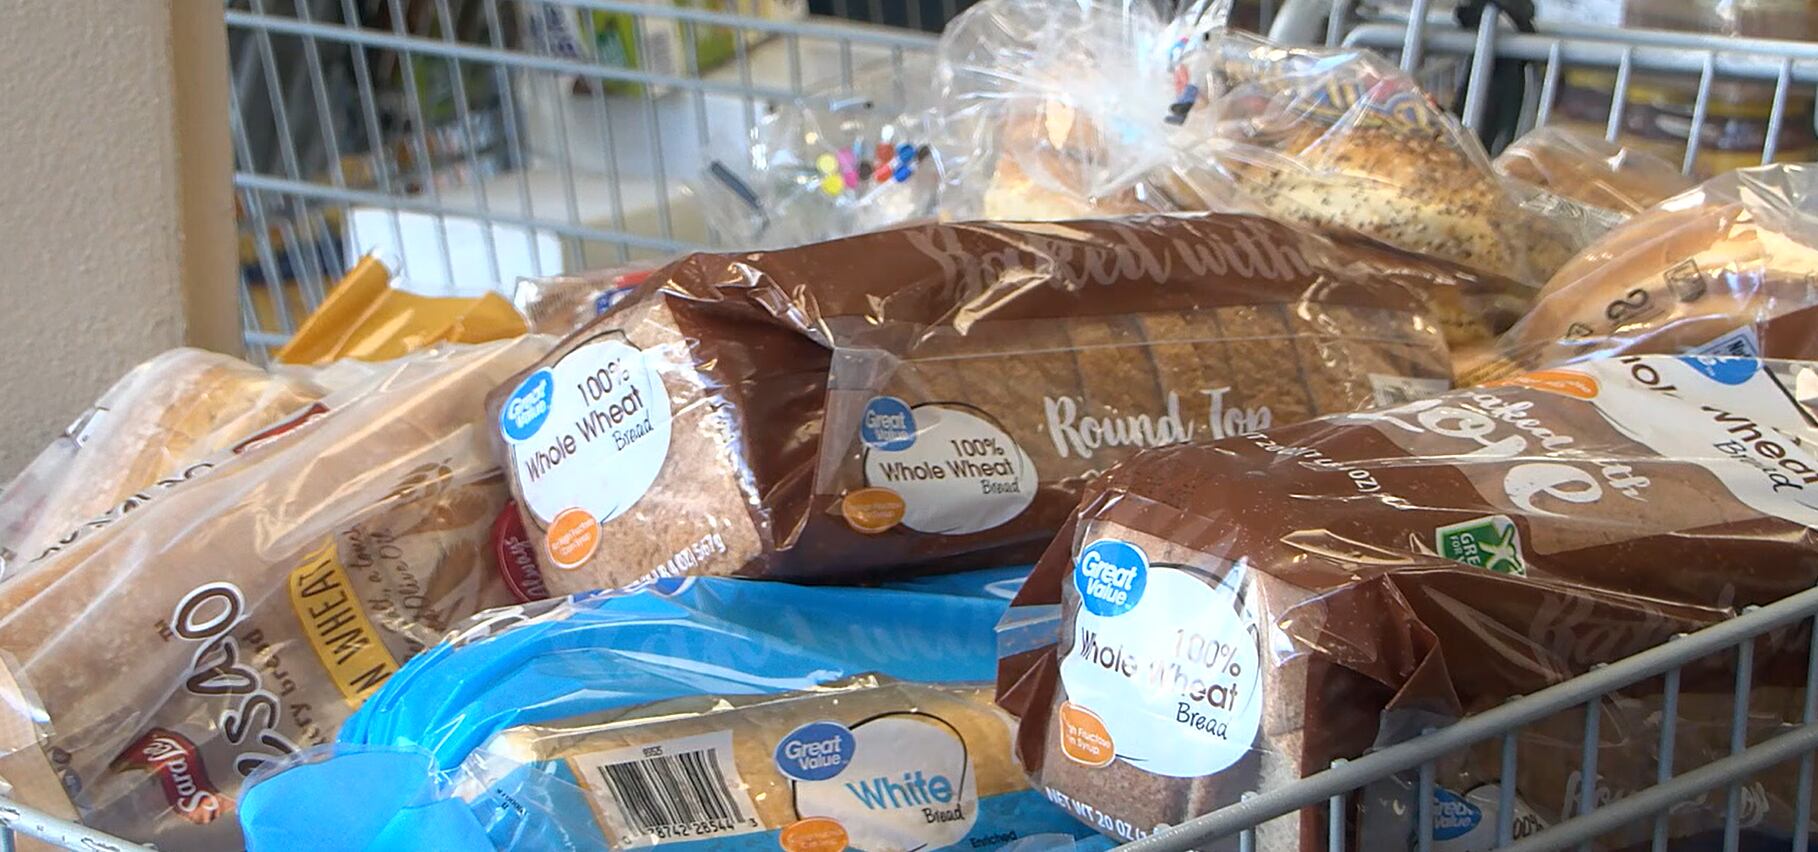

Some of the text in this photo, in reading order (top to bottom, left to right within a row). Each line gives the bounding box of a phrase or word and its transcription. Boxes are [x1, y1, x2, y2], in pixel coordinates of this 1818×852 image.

[1172, 219, 1313, 281] with
[508, 380, 547, 420] Great
[577, 357, 631, 408] 100%
[524, 384, 645, 483] Whole Wheat
[611, 409, 655, 451] Bread
[865, 410, 907, 431] Great
[1043, 386, 1273, 460] Round Top
[951, 436, 1005, 458] 100%
[879, 457, 1015, 483] Whole Wheat
[980, 476, 1021, 495] Bread
[1459, 532, 1482, 567] GRE
[1082, 550, 1139, 591] Great
[1086, 577, 1128, 606] Value
[298, 558, 371, 666] WHEAT
[1080, 626, 1138, 678] Whole
[1175, 628, 1242, 678] 100%
[784, 735, 843, 761] Great
[799, 751, 842, 771] Value
[142, 737, 219, 813] Sara Lee
[845, 769, 954, 811] White
[692, 821, 736, 837] 28544
[749, 817, 759, 828] 3
[921, 802, 966, 825] Bread
[1044, 786, 1074, 811] NET
[1072, 799, 1095, 823] WT
[1096, 811, 1114, 831] 20
[1116, 820, 1136, 842] OZ
[1511, 815, 1545, 842] 00%
